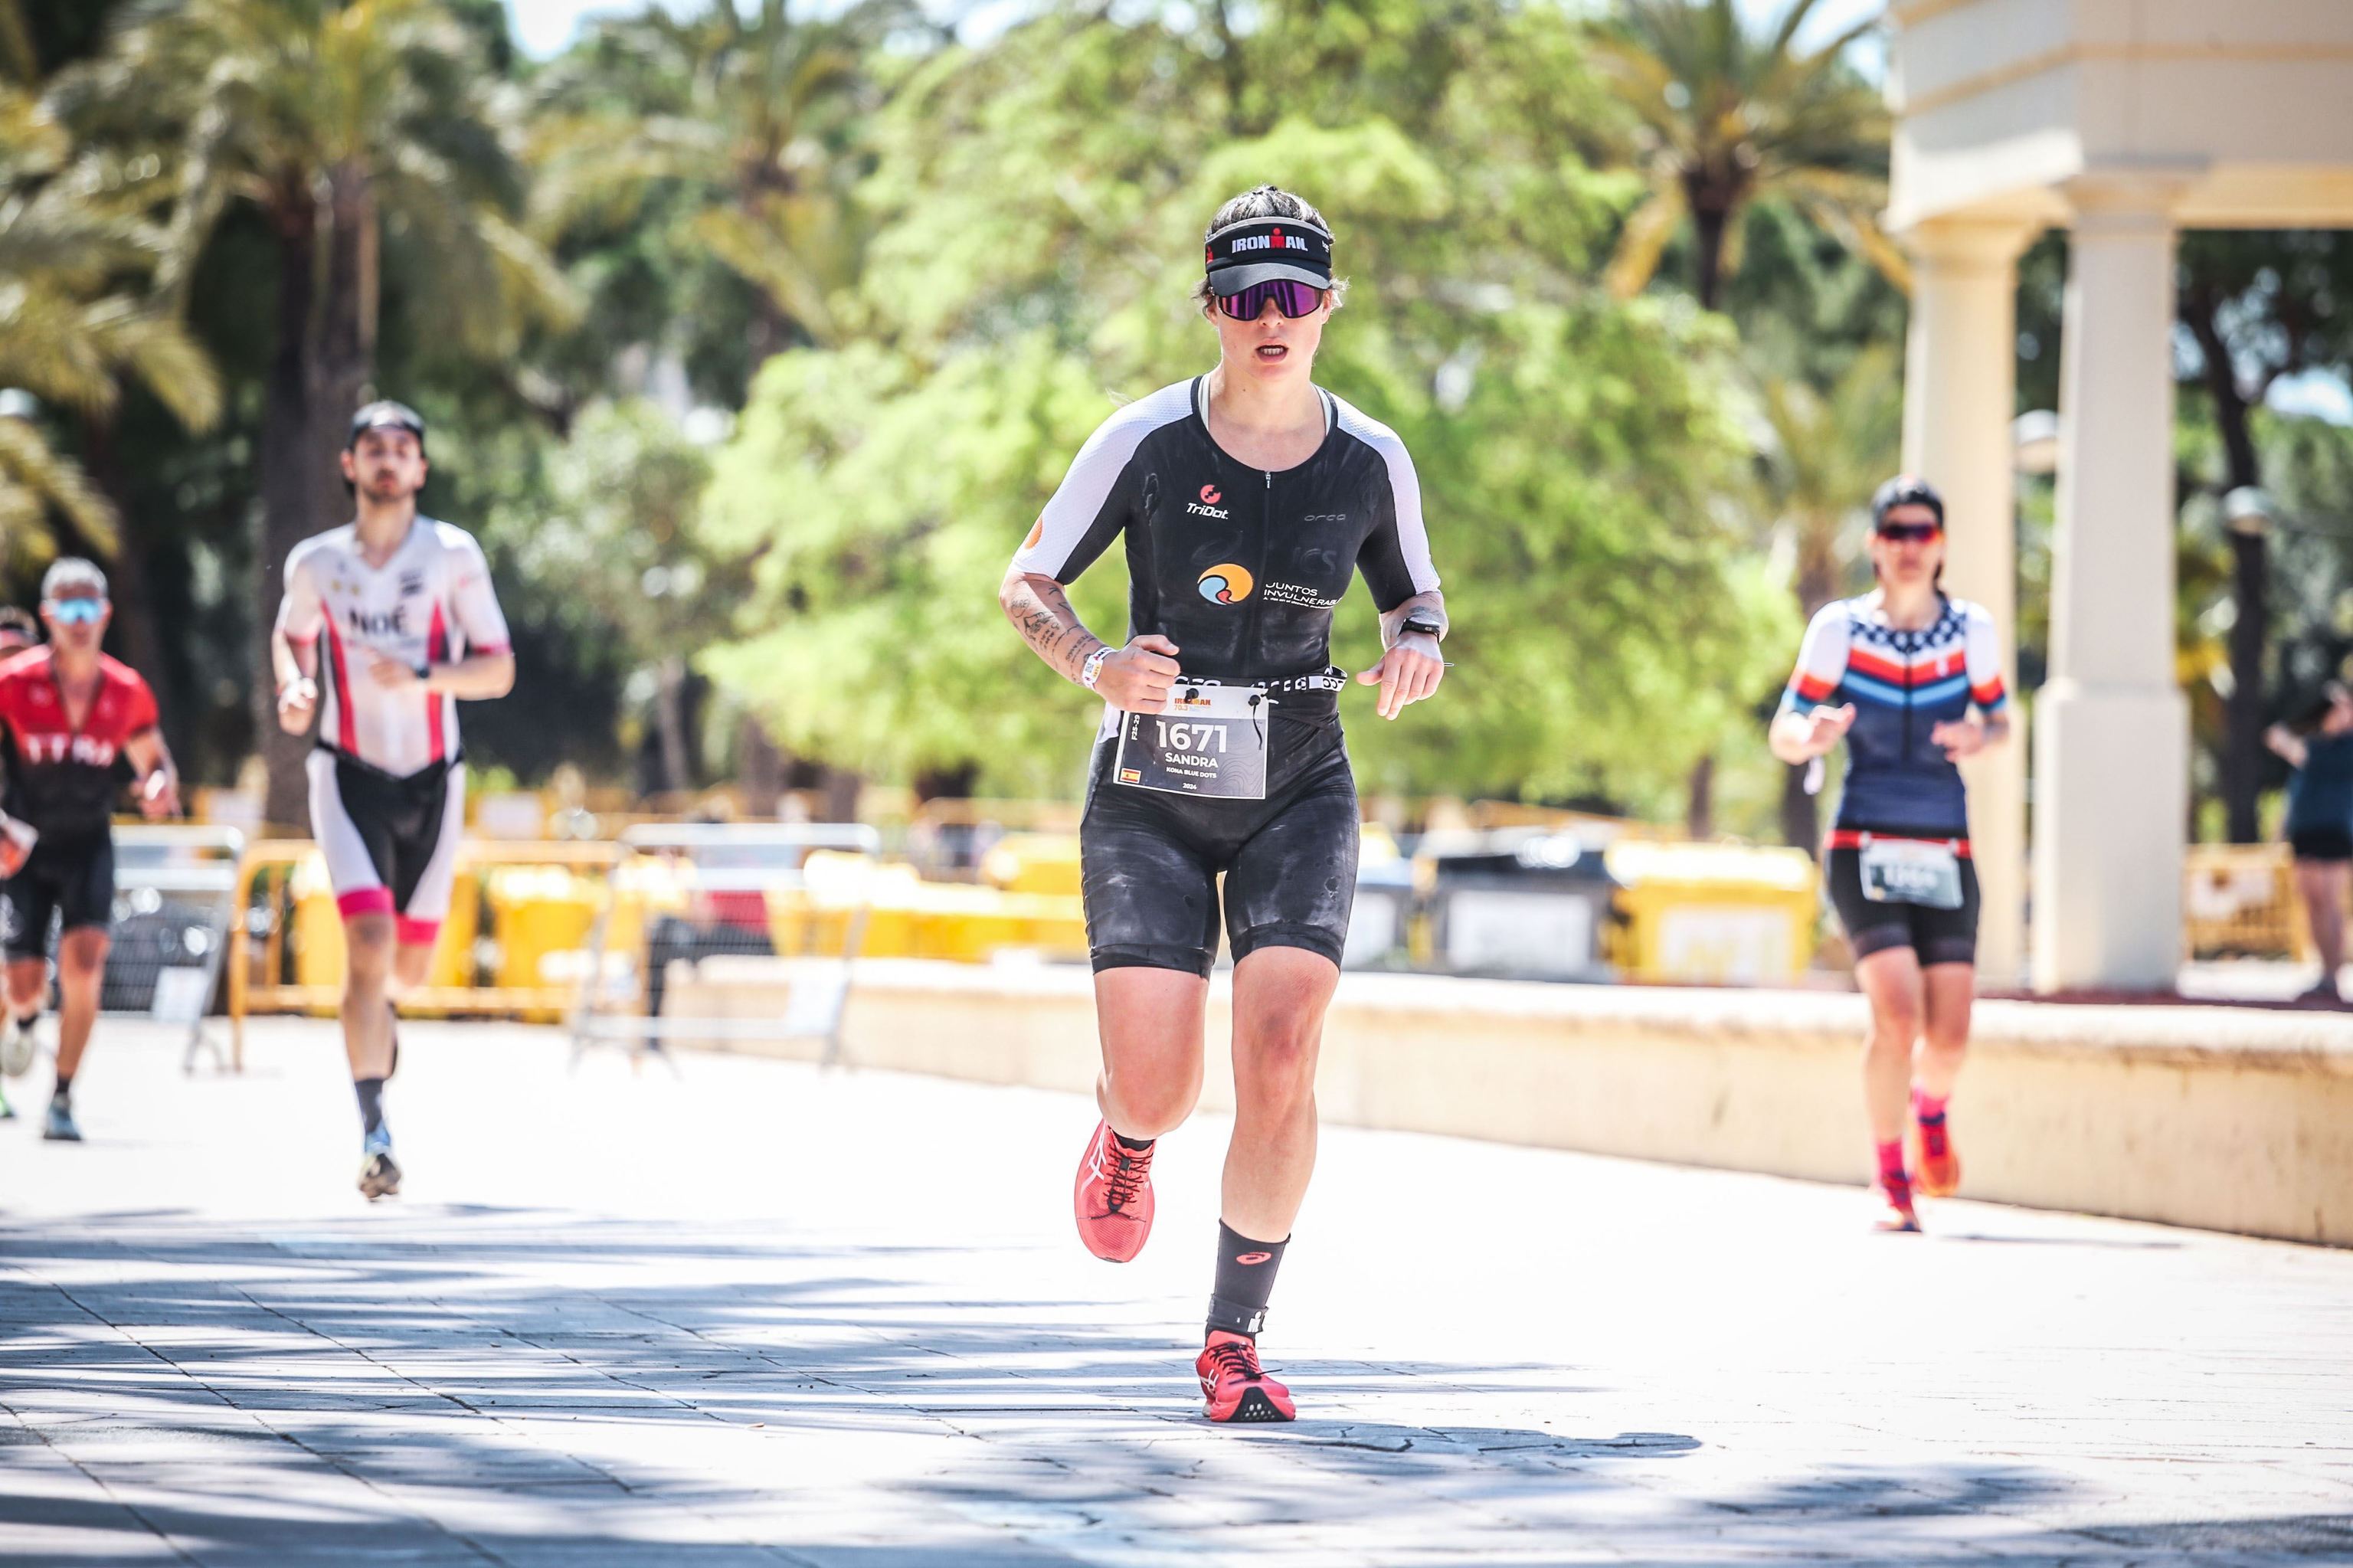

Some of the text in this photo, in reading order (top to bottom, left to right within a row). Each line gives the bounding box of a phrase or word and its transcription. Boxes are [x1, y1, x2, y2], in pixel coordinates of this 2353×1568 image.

[1232, 228, 1307, 254] IRONMAN
[1186, 502, 1229, 519] TriDot
[1265, 582, 1318, 597] JUNTOS
[1131, 714, 1141, 741] F25-29
[1156, 720, 1227, 753] 1671
[1165, 752, 1219, 768] SANDRA
